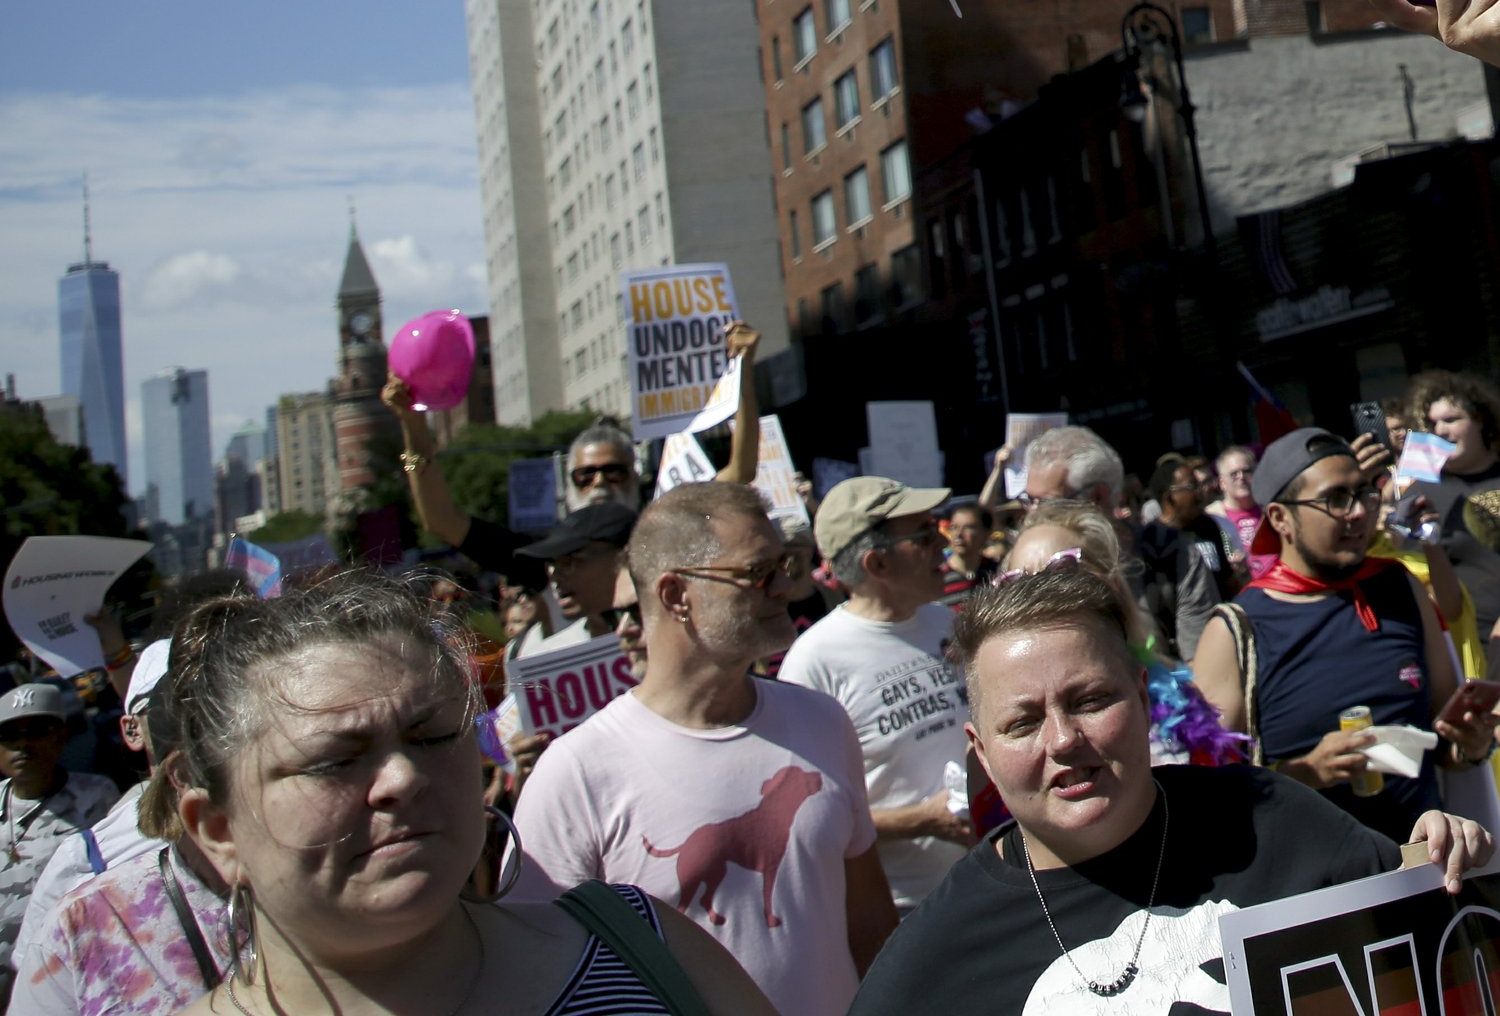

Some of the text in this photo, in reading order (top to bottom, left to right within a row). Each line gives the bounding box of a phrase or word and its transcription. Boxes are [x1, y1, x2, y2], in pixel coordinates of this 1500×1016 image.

[629, 275, 733, 325] HOUSE
[635, 313, 737, 357] UNDOC
[881, 677, 928, 706] GAYS,
